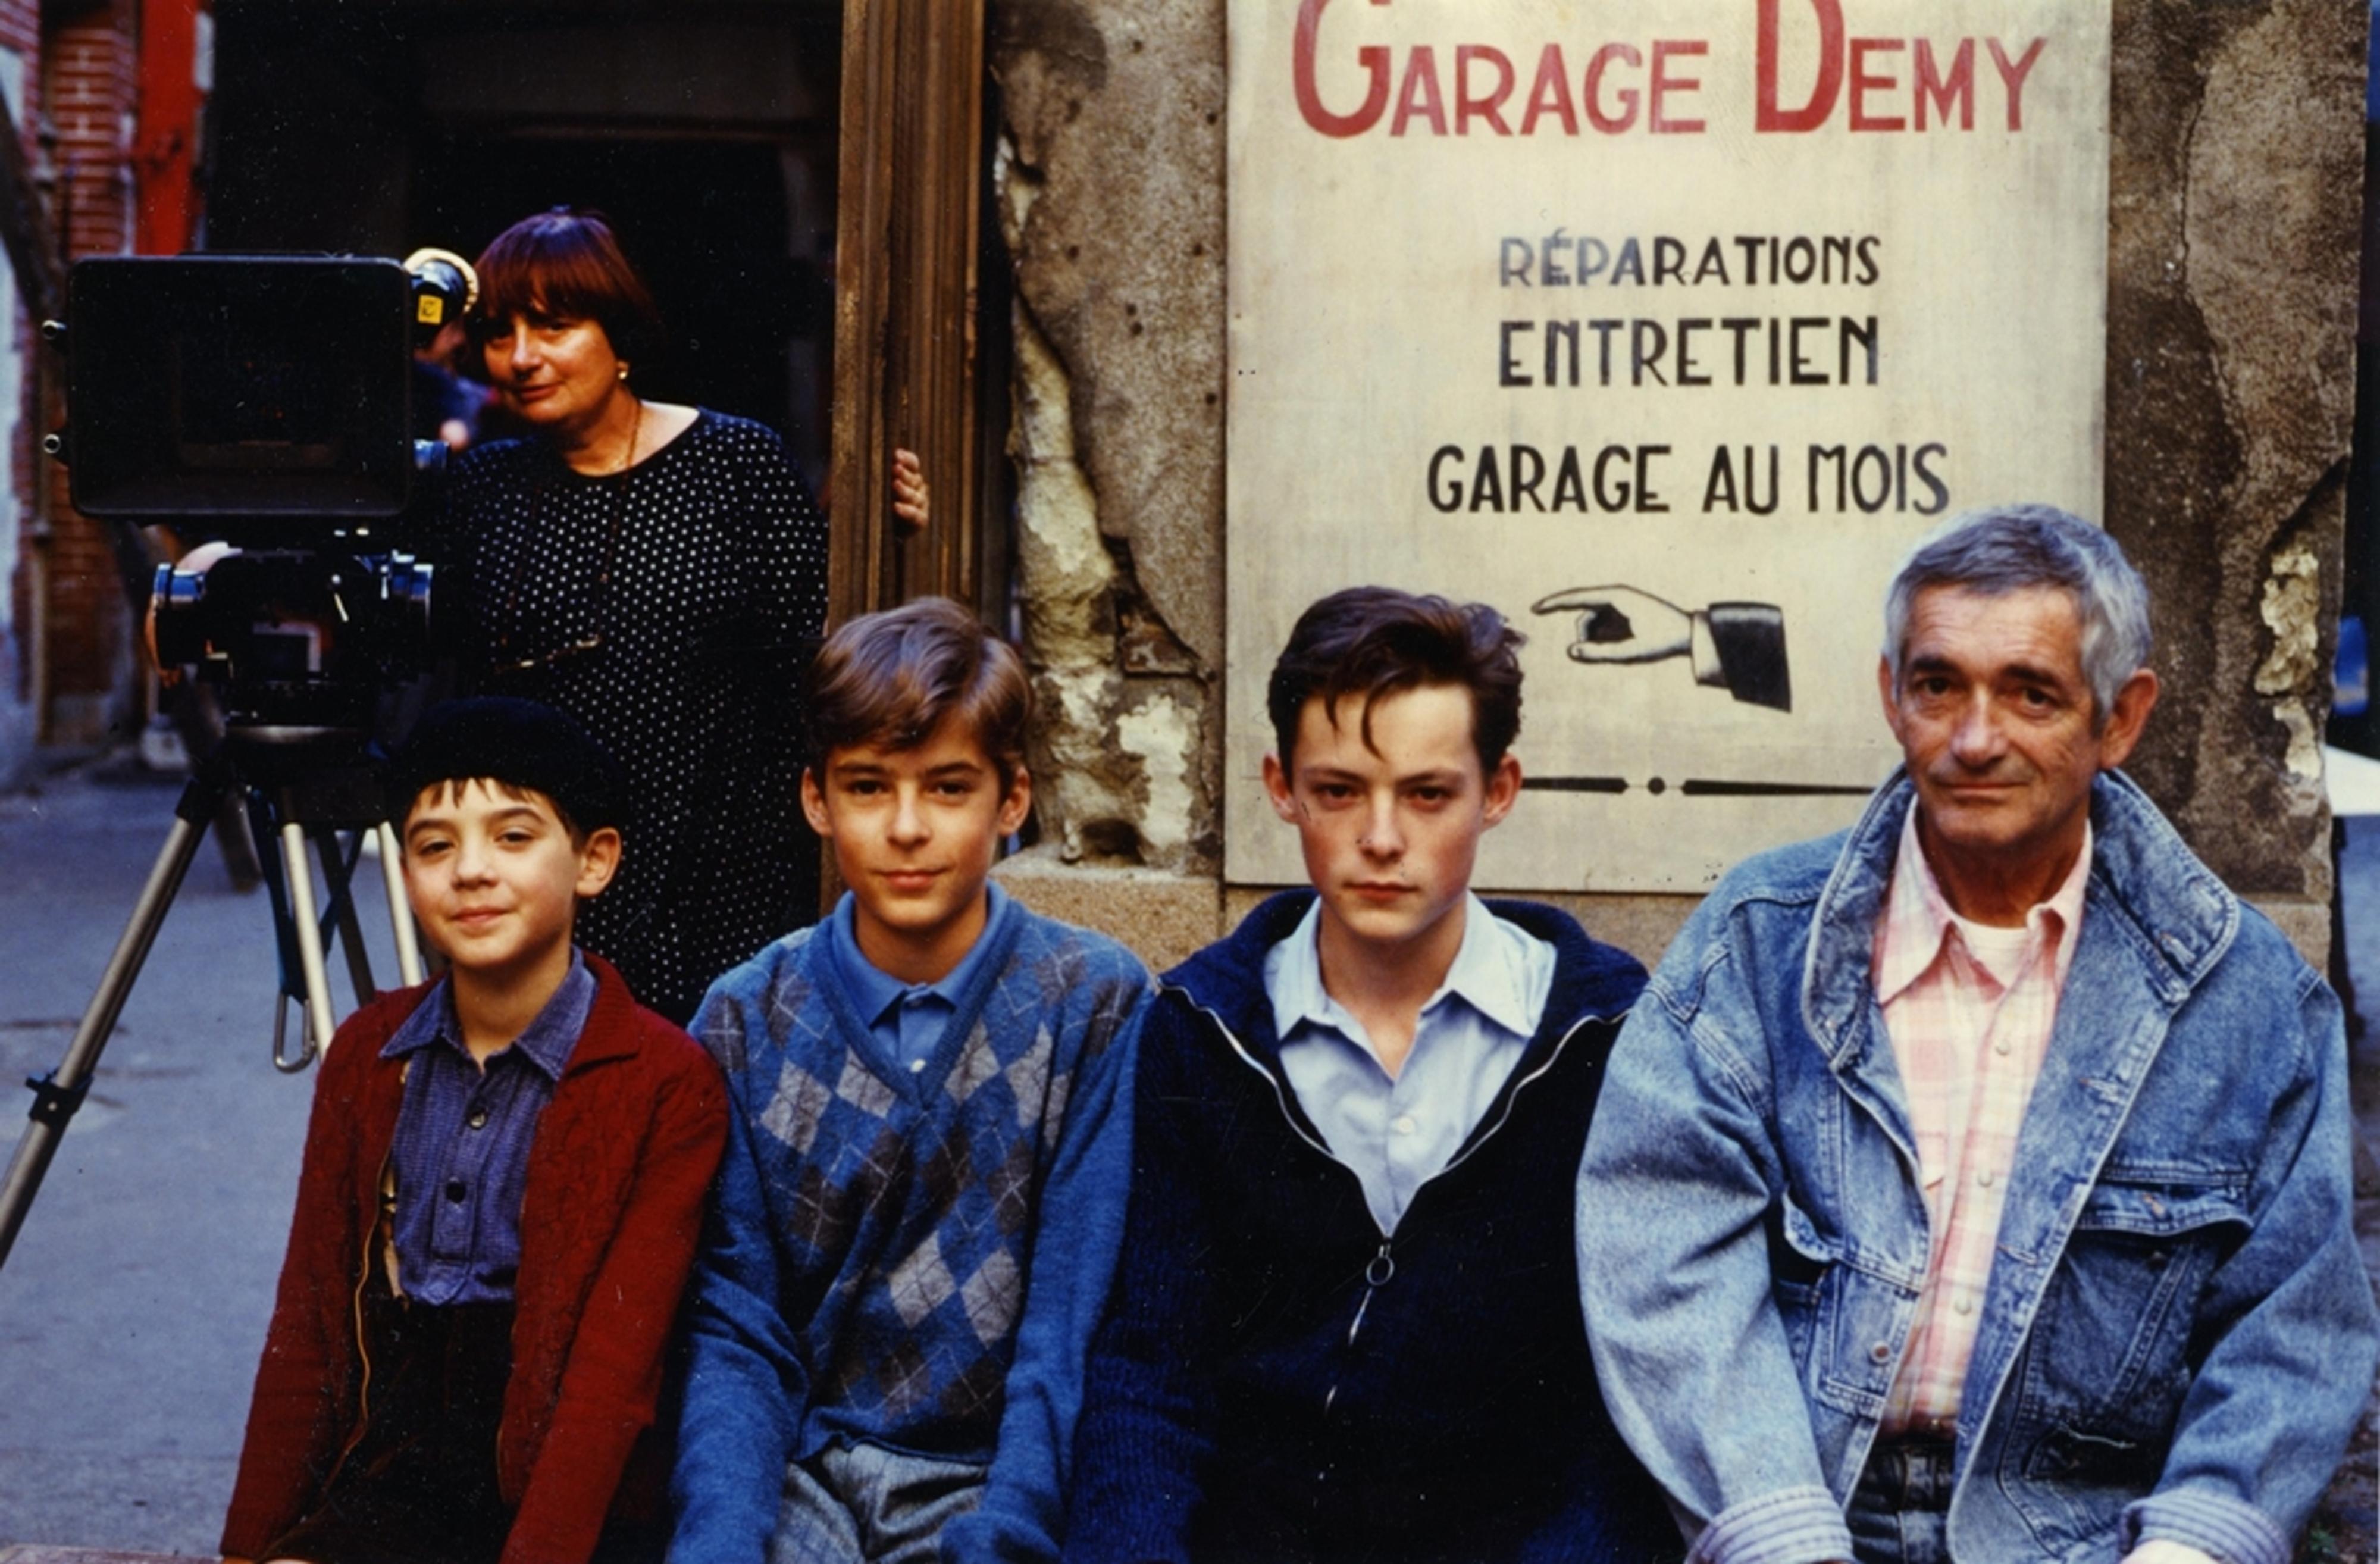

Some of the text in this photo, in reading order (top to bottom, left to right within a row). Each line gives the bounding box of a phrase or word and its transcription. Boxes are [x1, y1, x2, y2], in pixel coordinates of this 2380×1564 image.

[1291, 0, 2048, 139] GARAGE DEMY
[1498, 229, 1881, 287] RÉPARATIONS
[1498, 314, 1880, 389] ENTRETIEN
[1426, 441, 1950, 517] GARAGE AU MOIS
